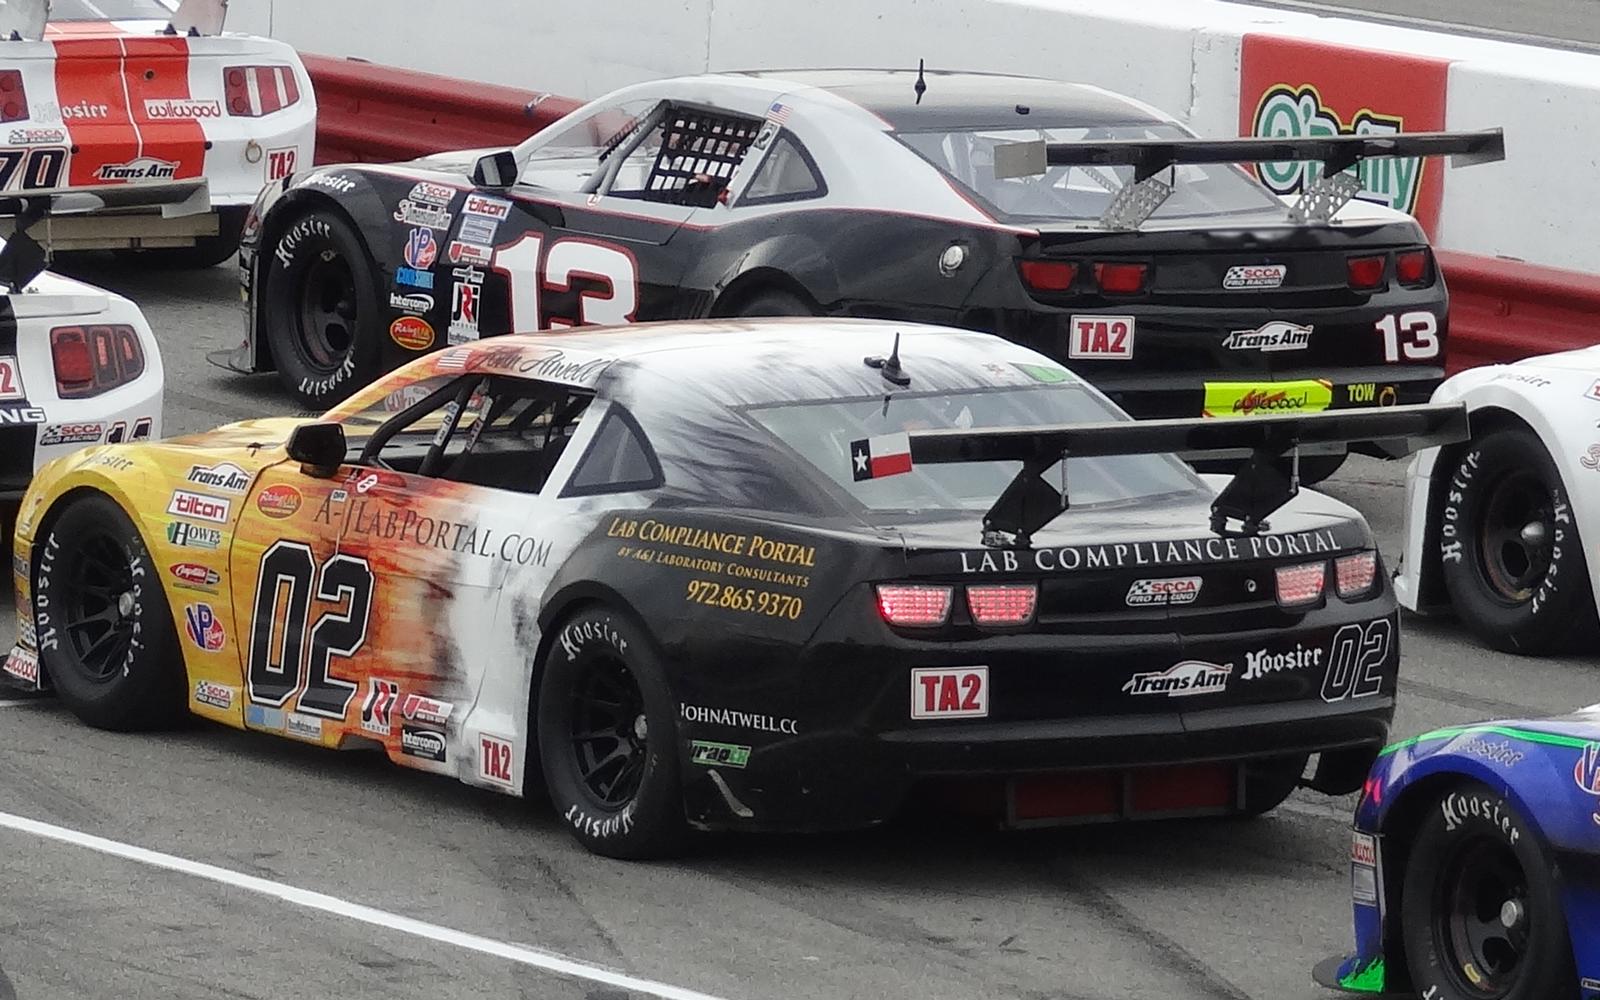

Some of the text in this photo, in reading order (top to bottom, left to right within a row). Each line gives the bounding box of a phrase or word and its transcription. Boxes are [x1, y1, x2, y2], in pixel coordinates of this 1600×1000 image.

[148, 100, 221, 118] wilwood
[0, 146, 68, 190] 70
[101, 164, 173, 178] Trans Am
[270, 151, 295, 180] TA2
[468, 197, 506, 217] tilton
[491, 230, 639, 334] 13
[1244, 268, 1281, 278] SCCA
[1078, 320, 1128, 353] TA2
[1231, 329, 1307, 347] Trans Am
[1376, 311, 1440, 361] 13
[1347, 383, 1376, 402] TOW
[61, 424, 102, 434] SCCA
[188, 466, 248, 490] Trans Am
[176, 495, 225, 518] tilton
[1440, 449, 1481, 565] Hoosier
[608, 517, 816, 567] LAB COMPLIANCE PORTAL
[960, 529, 1342, 573] LAB COMPLIANCE PORTAL
[617, 546, 630, 557] BY
[656, 551, 724, 573] LABORATORY
[726, 562, 811, 588] CONSULTANTS
[685, 579, 803, 620] 972.865.9370
[1151, 581, 1196, 592] SCCA
[247, 538, 375, 721] 02
[560, 617, 628, 662] Hoosier
[1240, 643, 1322, 680] Hoosier
[1320, 618, 1391, 703] 02
[207, 686, 231, 699] SCCA
[919, 675, 982, 713] TA2
[1131, 675, 1190, 692] Trans
[1191, 670, 1226, 688] Am
[402, 728, 442, 753] Intercomp
[482, 738, 511, 781] TA2
[1441, 792, 1520, 845] Hoosier
